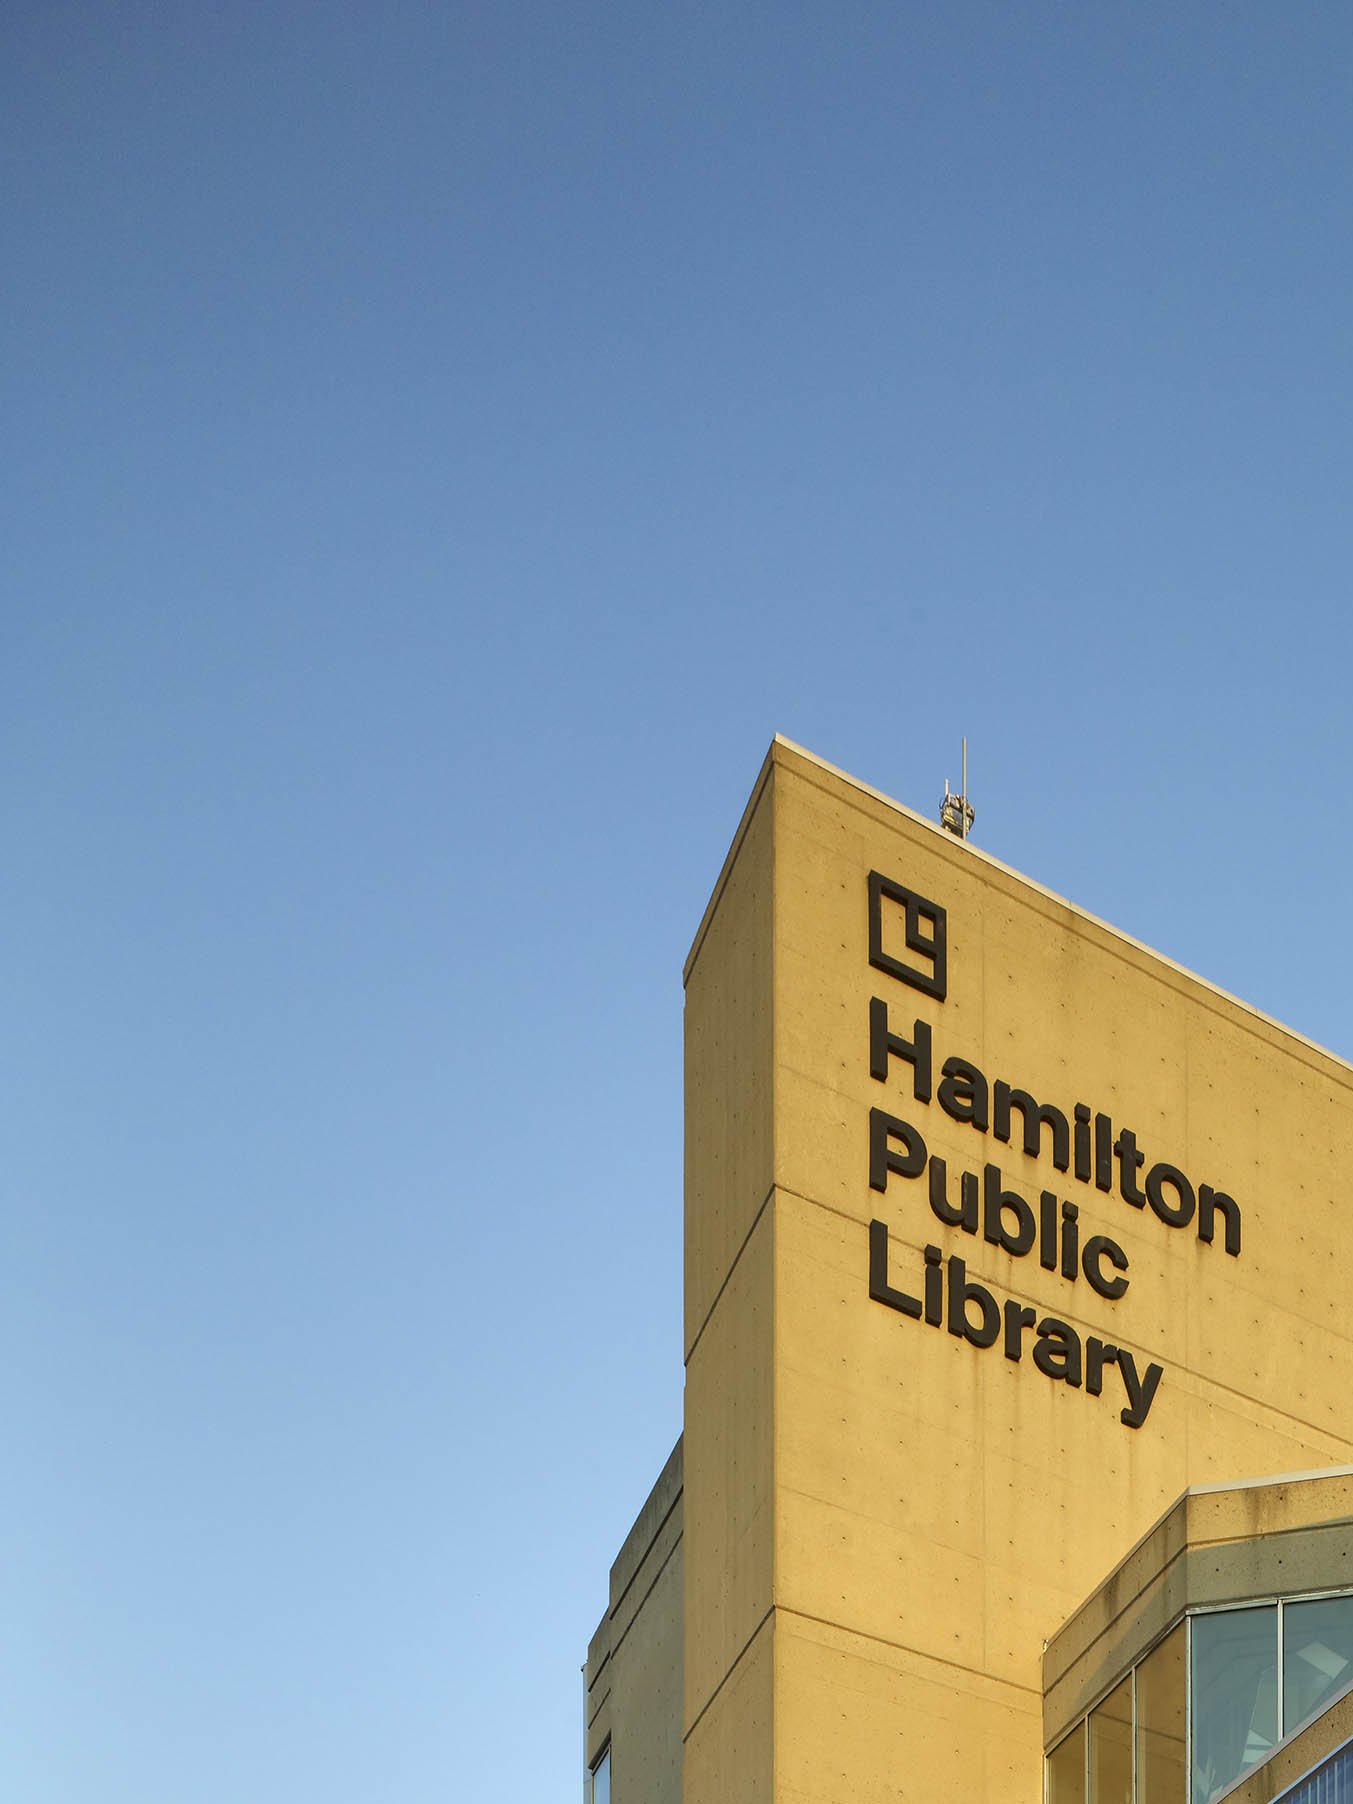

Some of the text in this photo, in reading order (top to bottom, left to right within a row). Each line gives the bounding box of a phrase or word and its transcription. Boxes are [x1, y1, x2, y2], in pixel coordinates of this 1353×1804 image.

[869, 996, 1242, 1258] Hamilton
[869, 1106, 1130, 1300] Public
[869, 1218, 1164, 1430] Library
